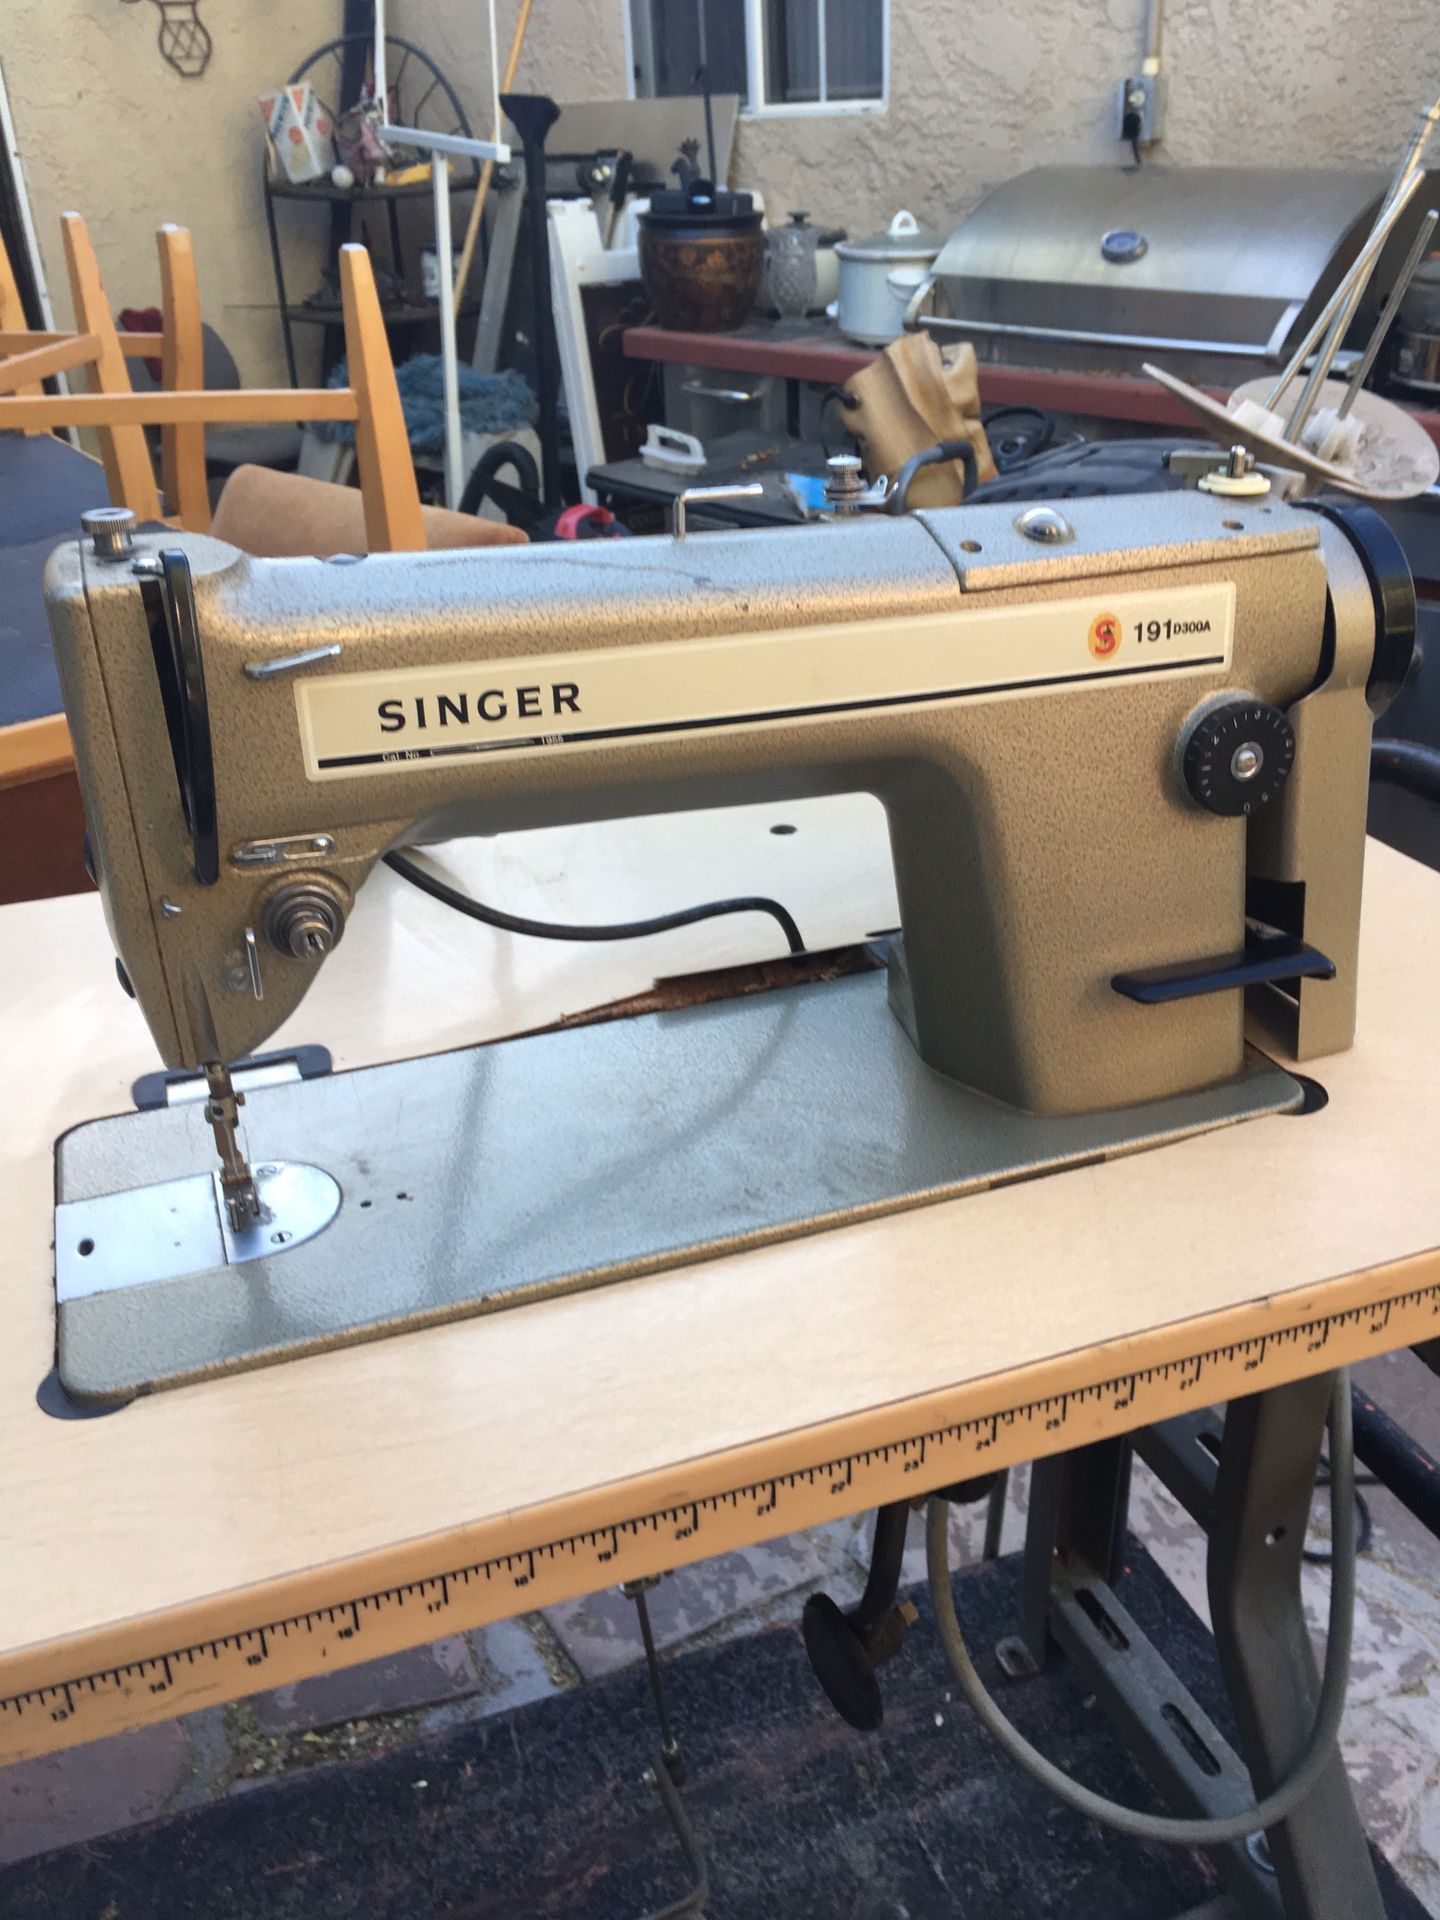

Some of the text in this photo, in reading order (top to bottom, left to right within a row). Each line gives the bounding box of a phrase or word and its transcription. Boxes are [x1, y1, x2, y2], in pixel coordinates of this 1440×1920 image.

[378, 682, 582, 733] SINGER
[675, 1526, 692, 1541] 20
[757, 1503, 771, 1517] 21
[831, 1481, 846, 1494] 22
[903, 1460, 920, 1473] 23
[976, 1439, 991, 1451] 24
[1045, 1418, 1061, 1431] 25
[1114, 1399, 1129, 1411] 26
[1307, 1340, 1322, 1352] 29
[1369, 1322, 1383, 1334] 30
